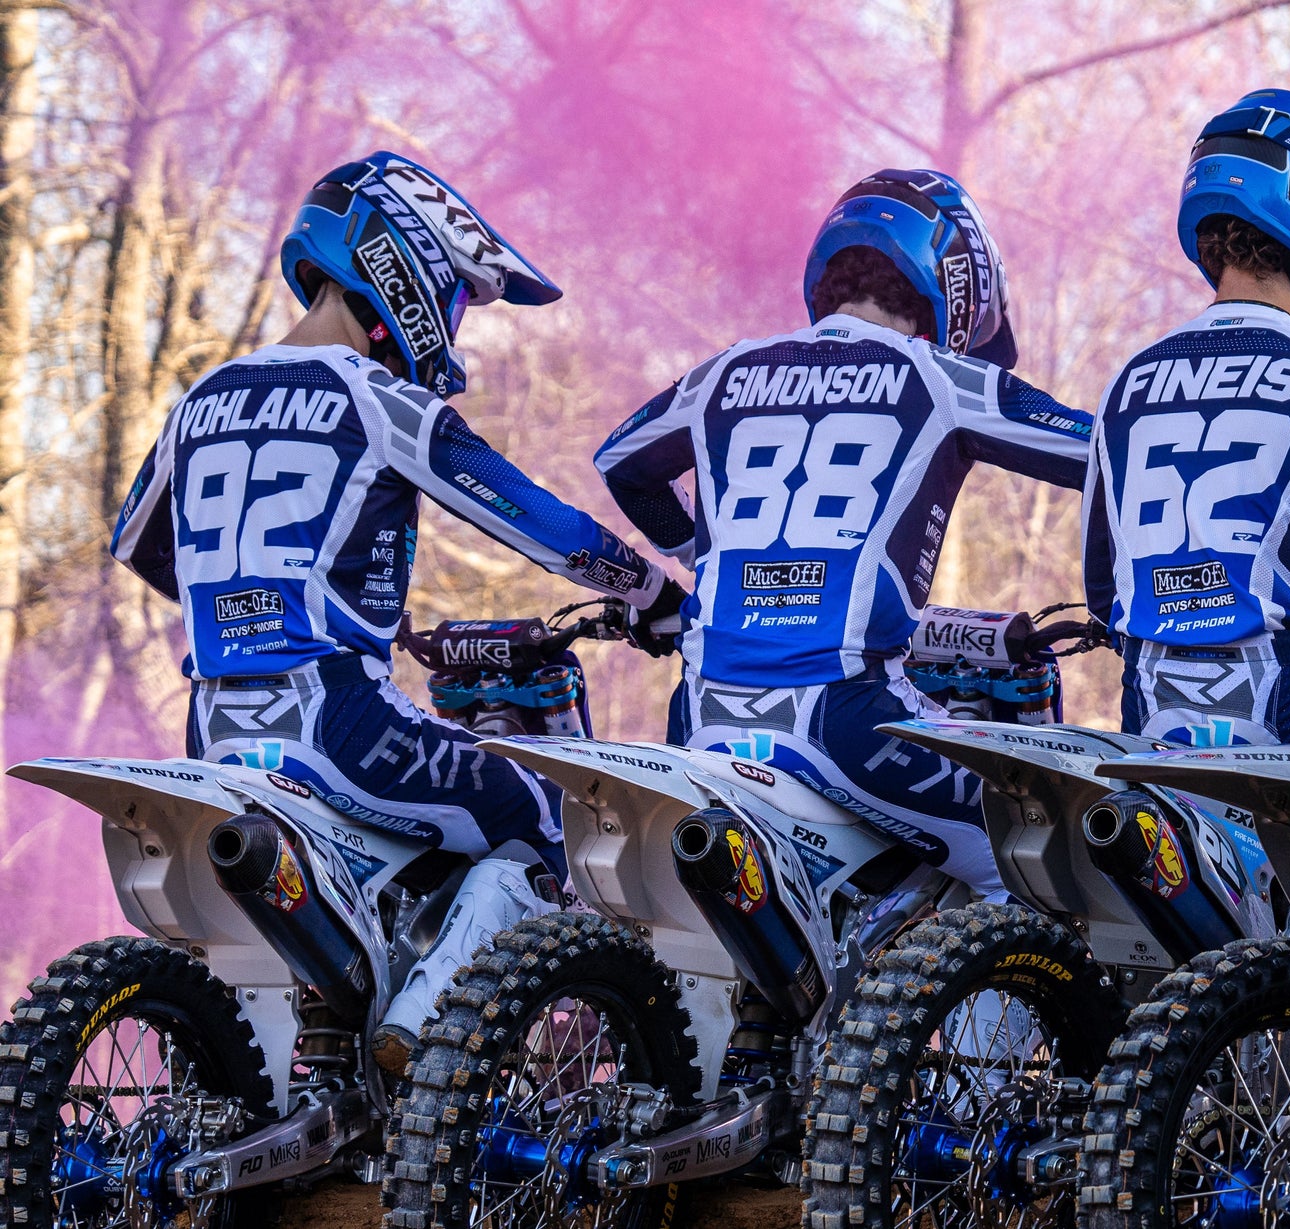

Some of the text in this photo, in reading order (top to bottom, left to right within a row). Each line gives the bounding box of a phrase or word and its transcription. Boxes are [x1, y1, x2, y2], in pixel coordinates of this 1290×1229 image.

[361, 182, 456, 290] RIDE
[364, 241, 439, 355] Muc-Off
[948, 260, 969, 352] Muc-O
[721, 362, 910, 411] SIMONSON
[179, 387, 349, 444] VOHLAND
[1028, 411, 1092, 436] CLUBM
[454, 472, 527, 519] CLUBMX
[717, 413, 903, 550] 88
[176, 439, 341, 585] 92
[747, 563, 822, 587] Muc-Off
[219, 591, 281, 620] Muc-Off
[742, 592, 822, 608] ATVS&MORE
[1157, 593, 1236, 615] ATVS&MORE
[220, 619, 284, 639] ATVS&MORE
[925, 620, 997, 652] Mika
[442, 638, 511, 666] Mika
[931, 641, 973, 651] Metals
[359, 725, 486, 791] FXR
[1003, 734, 1085, 756] DUNLOP
[128, 765, 204, 783] DUNLOP
[599, 751, 673, 774] DUNLOP
[734, 763, 774, 783] GUTS
[863, 735, 983, 807] FX
[269, 774, 310, 796] GUTS
[347, 804, 418, 834] YAMAHA
[843, 800, 920, 842] YAMAHA
[1224, 807, 1255, 829] FX
[330, 825, 366, 851] FXR
[792, 824, 828, 851] FXR
[1000, 953, 1073, 982] DUNLOP
[1129, 953, 1157, 963] ICON
[81, 983, 141, 1042] DUNLOP
[269, 1139, 300, 1168] Mika
[697, 1134, 731, 1165] Mika
